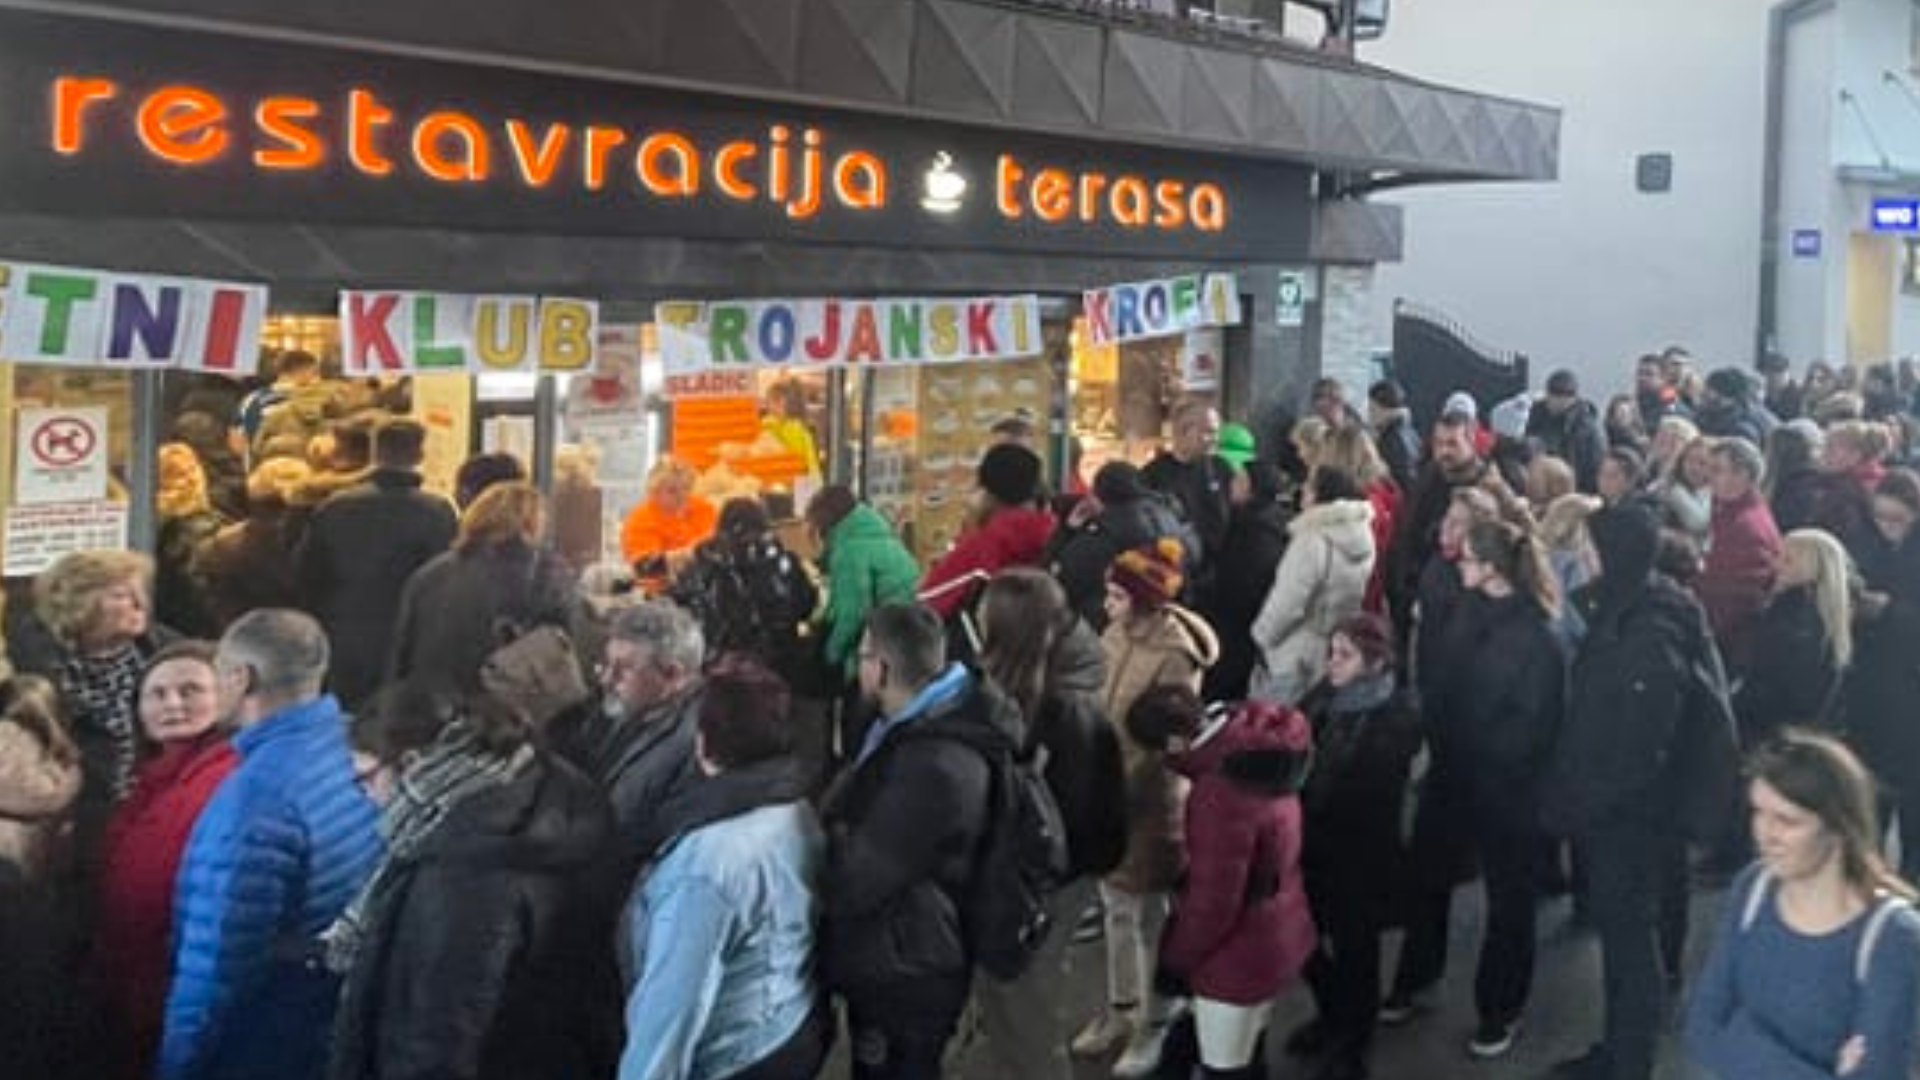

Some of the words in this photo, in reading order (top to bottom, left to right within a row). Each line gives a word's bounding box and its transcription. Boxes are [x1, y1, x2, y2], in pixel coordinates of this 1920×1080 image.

[52, 76, 886, 217] restavracija
[995, 153, 1225, 230] terasa
[0, 265, 248, 369] TNI
[345, 293, 593, 370] KLUB
[1086, 276, 1228, 343] KROFI
